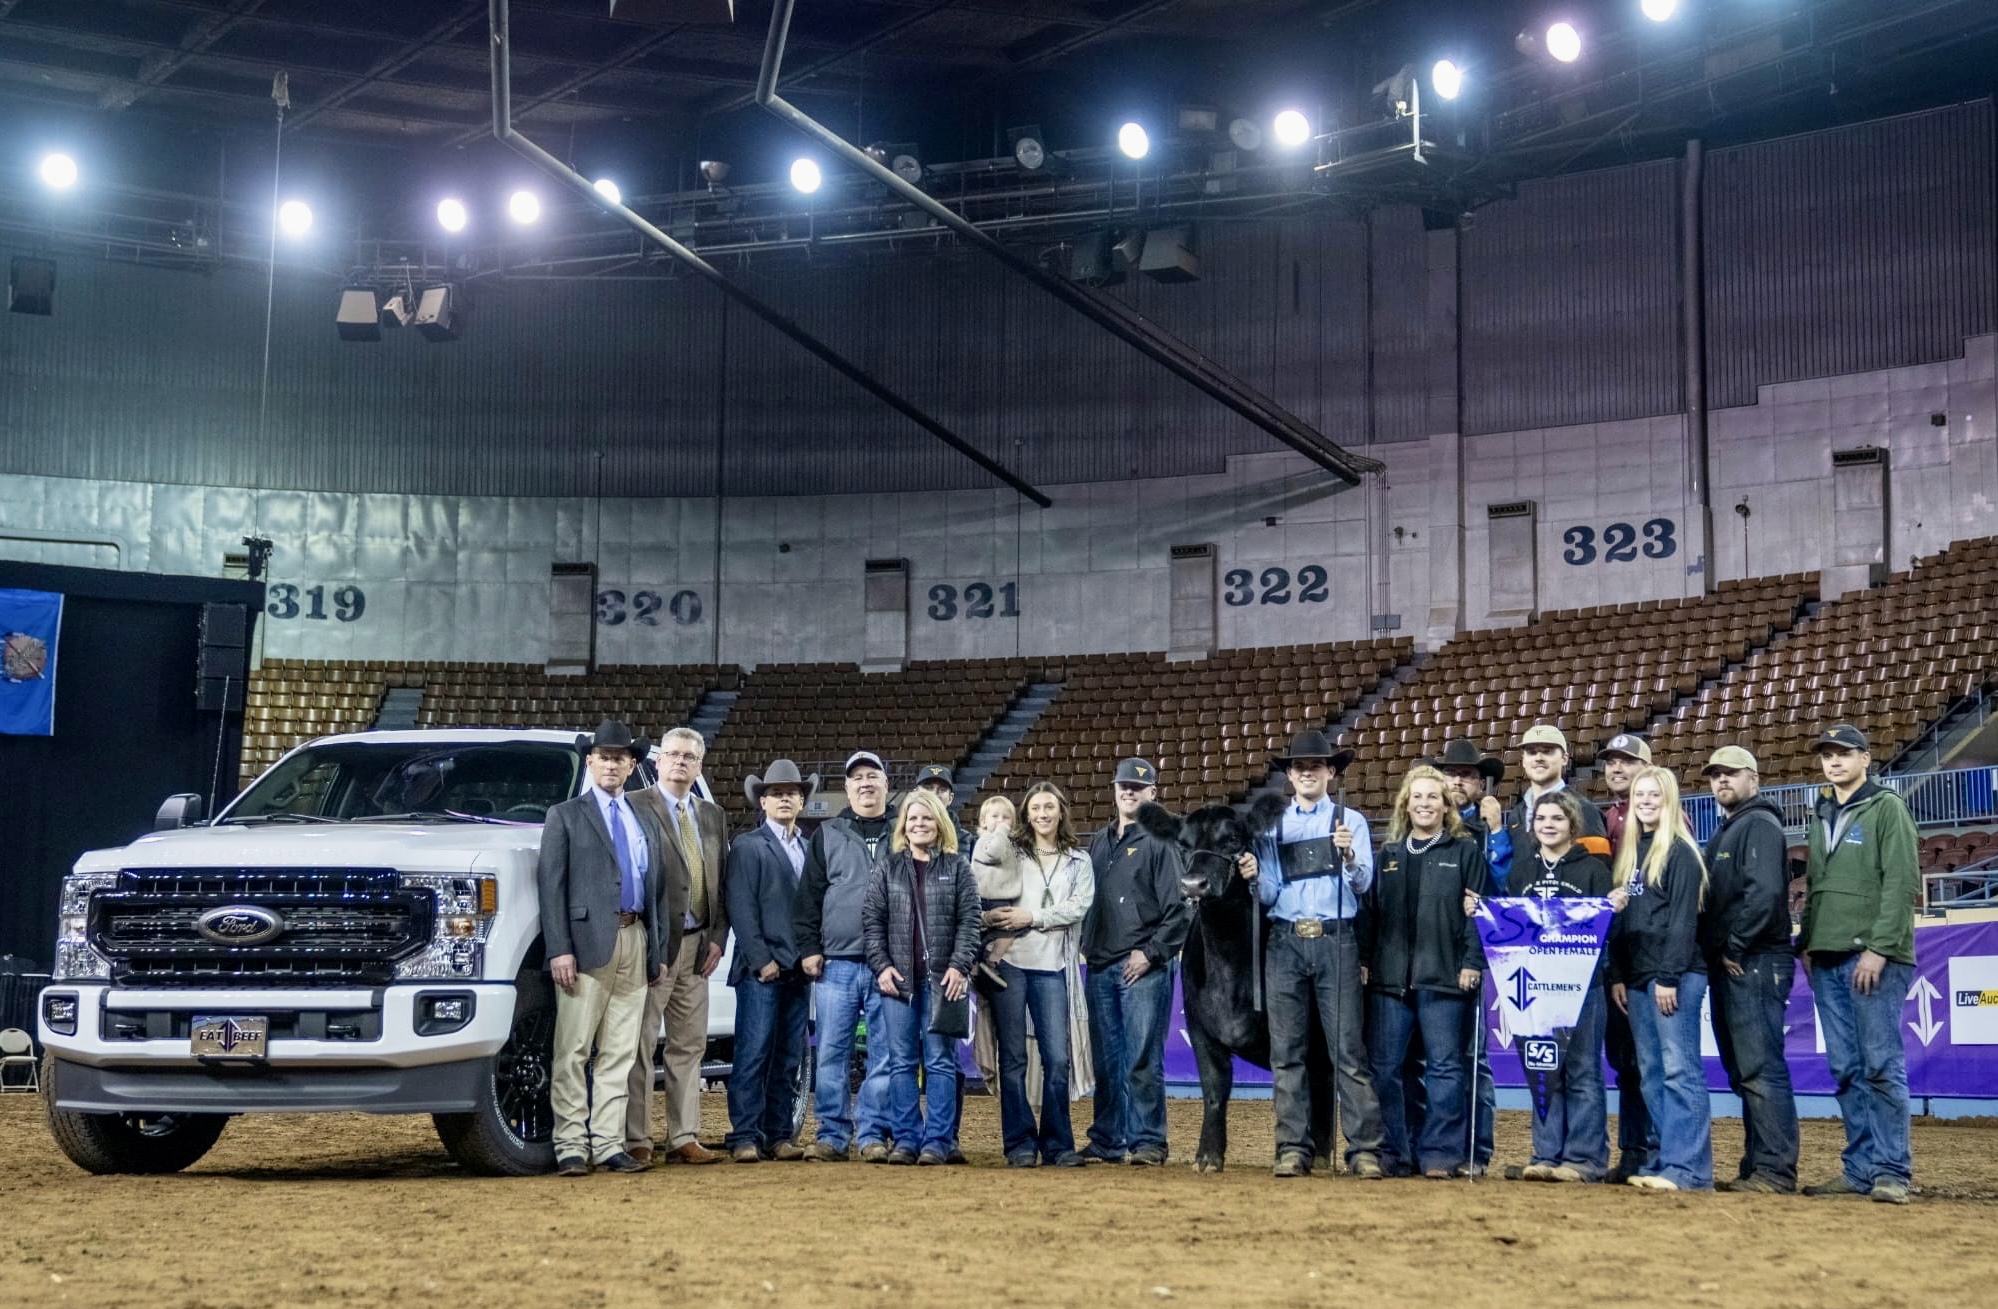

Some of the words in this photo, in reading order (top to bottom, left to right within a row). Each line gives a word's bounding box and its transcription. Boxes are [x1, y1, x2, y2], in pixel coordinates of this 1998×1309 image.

[1563, 517, 1677, 566] 323
[1224, 564, 1329, 607] 322
[267, 583, 366, 623] 319
[597, 589, 703, 626] 320
[927, 582, 1020, 621] 321
[218, 915, 258, 934] Ford
[1540, 934, 1598, 944] CHAMPION
[1528, 946, 1556, 956] OPEN
[1558, 947, 1598, 956] FEMALE
[1527, 983, 1582, 992] CATTLEMEN'S
[200, 1030, 223, 1041] EAT
[233, 1030, 263, 1041] BEEF
[1528, 1043, 1554, 1063] S/S
